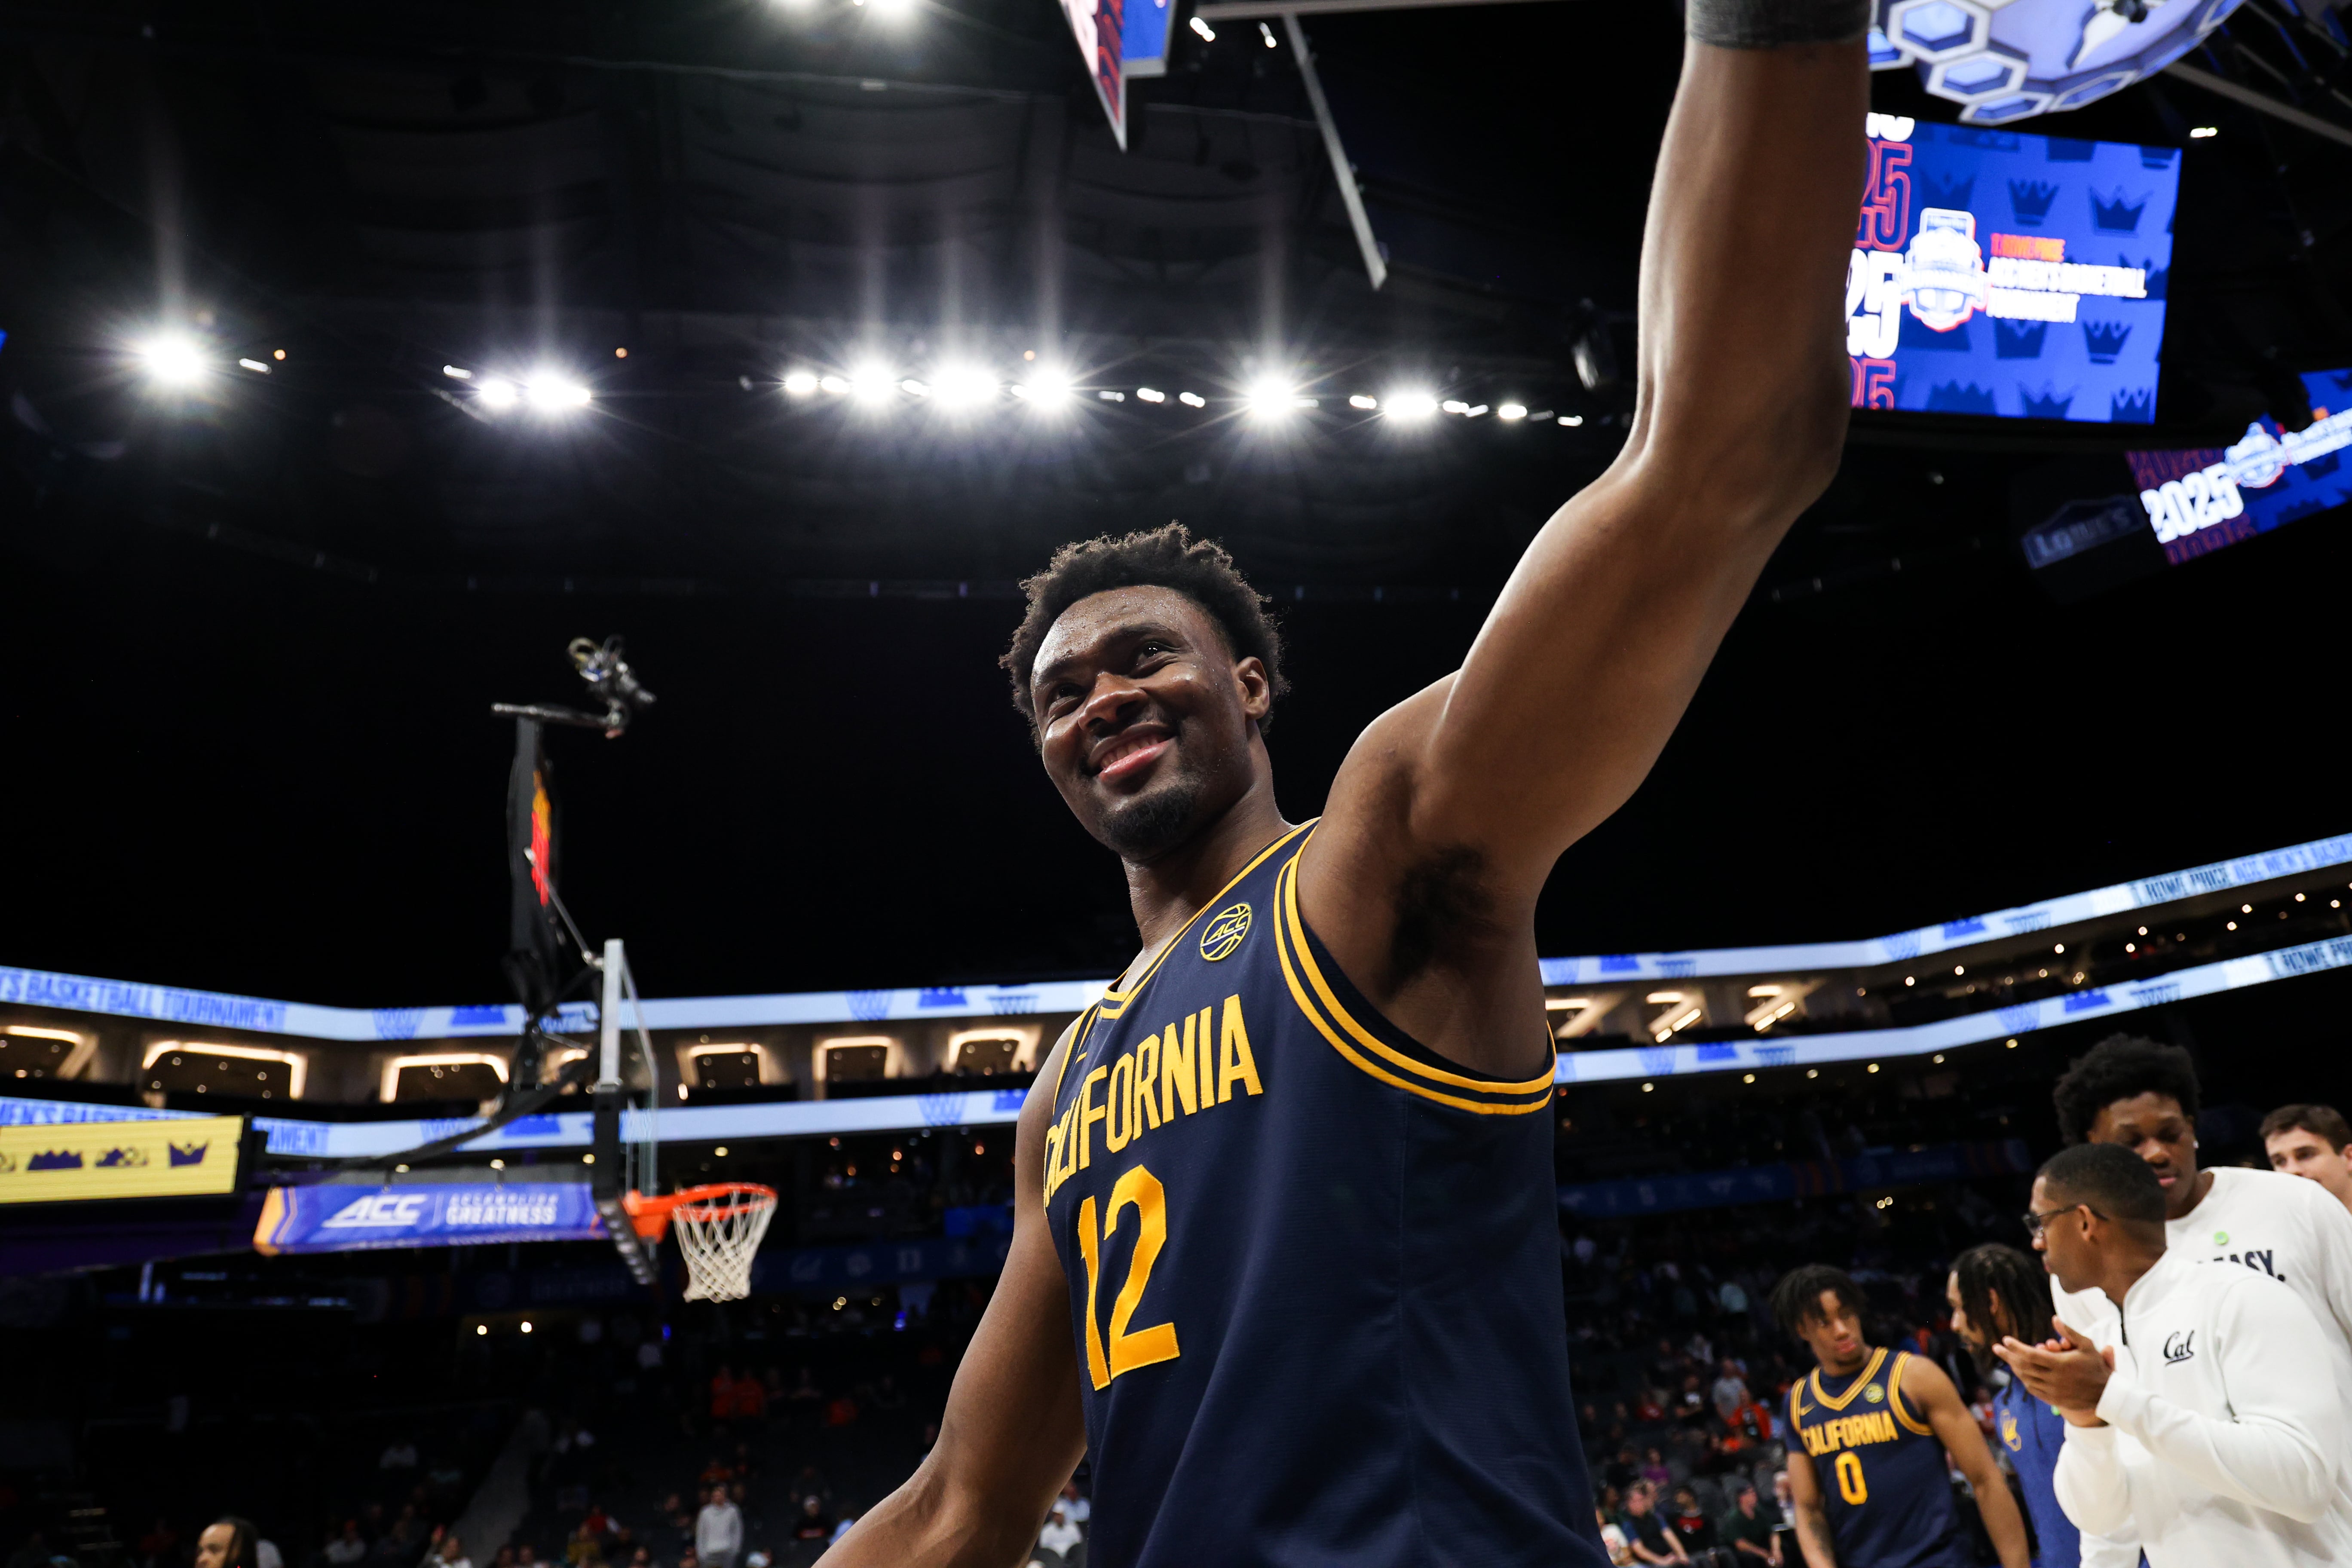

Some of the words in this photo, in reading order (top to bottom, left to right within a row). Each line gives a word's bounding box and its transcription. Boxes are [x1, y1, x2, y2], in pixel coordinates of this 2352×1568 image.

[2139, 461, 2245, 544] 2025
[1043, 994, 1263, 1217] CALIFORNIA
[322, 1194, 428, 1228] ACC
[445, 1205, 558, 1225] GREATNESS
[1078, 1164, 1180, 1392] 12
[2213, 1249, 2286, 1282] SY.
[2164, 1329, 2194, 1367] Cal
[1800, 1410, 1899, 1457] CALIFORNIA
[1834, 1451, 1868, 1505] 0
